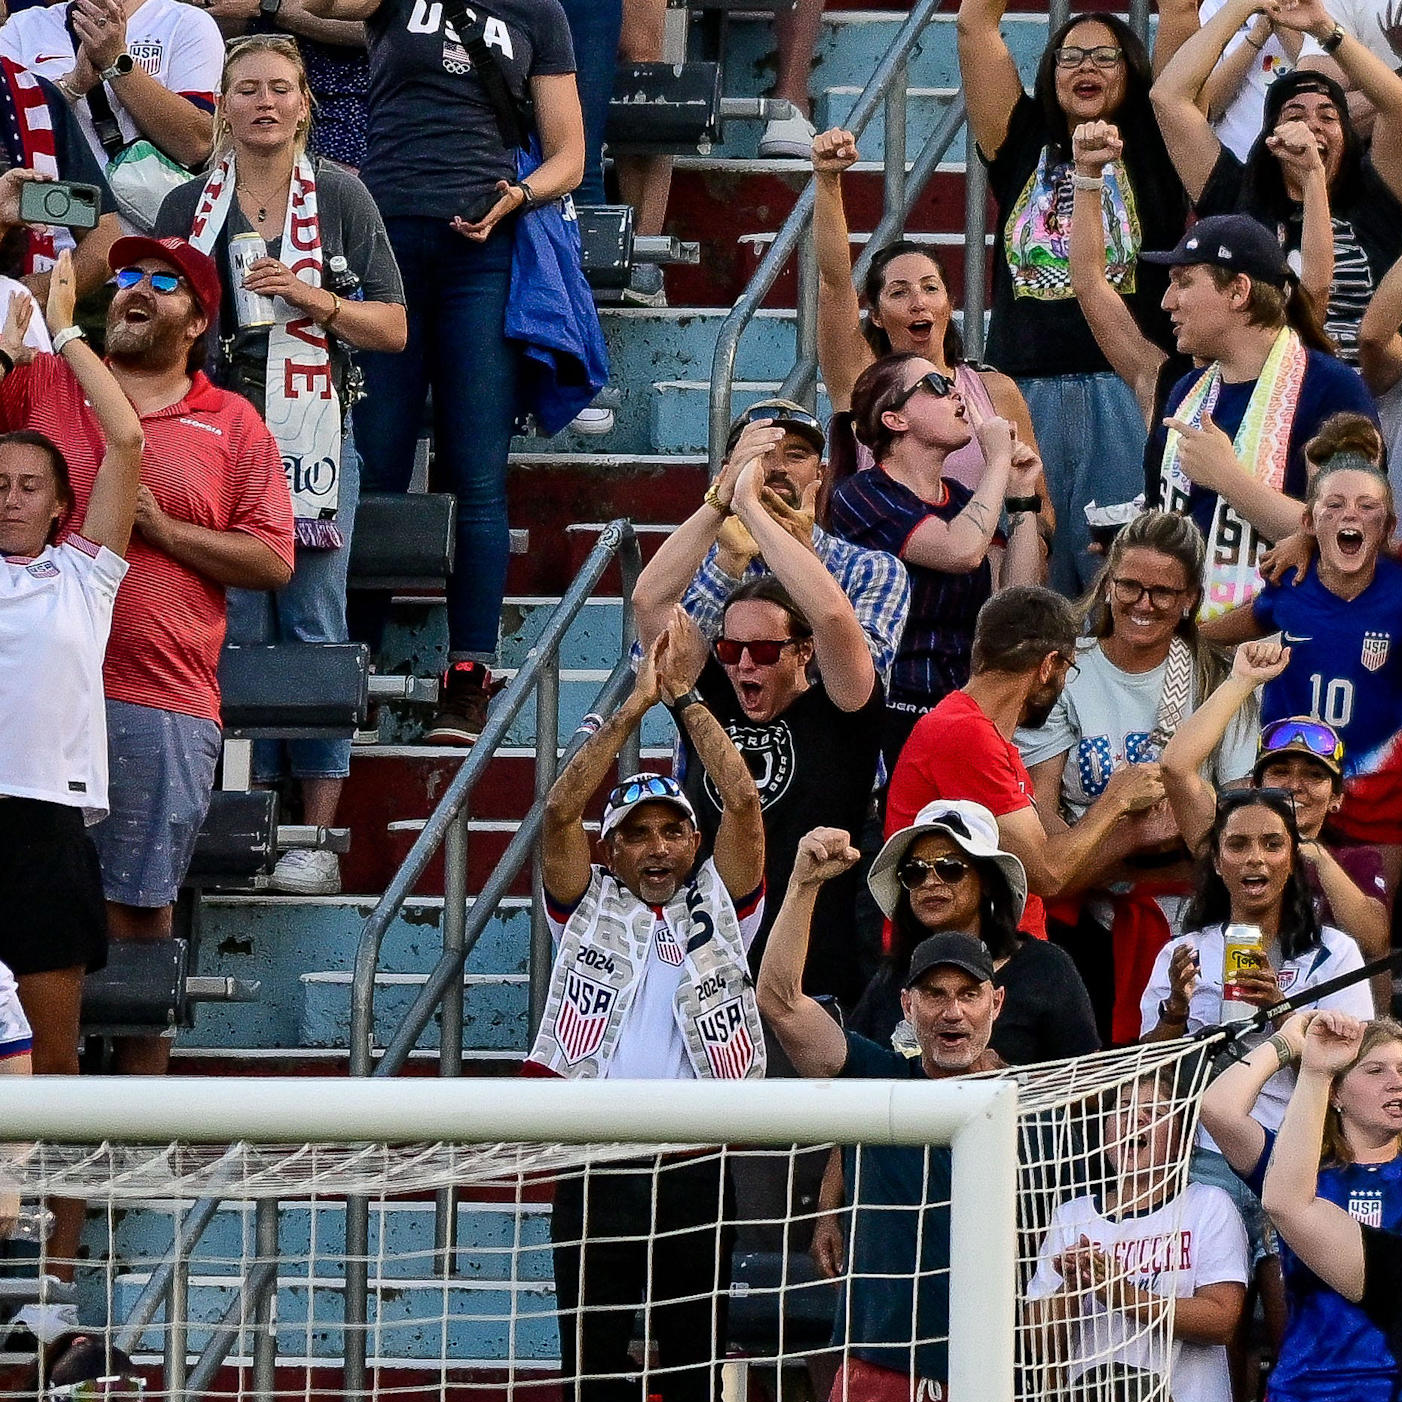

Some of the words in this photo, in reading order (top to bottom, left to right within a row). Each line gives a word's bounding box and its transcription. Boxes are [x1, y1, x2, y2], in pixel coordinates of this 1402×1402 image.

[131, 46, 159, 58] USA
[1310, 674, 1355, 729] 10
[577, 944, 616, 974] 2024
[568, 975, 613, 1016] USA
[696, 974, 728, 1001] 2024
[701, 1000, 741, 1043] USA
[1351, 1201, 1380, 1215] USA
